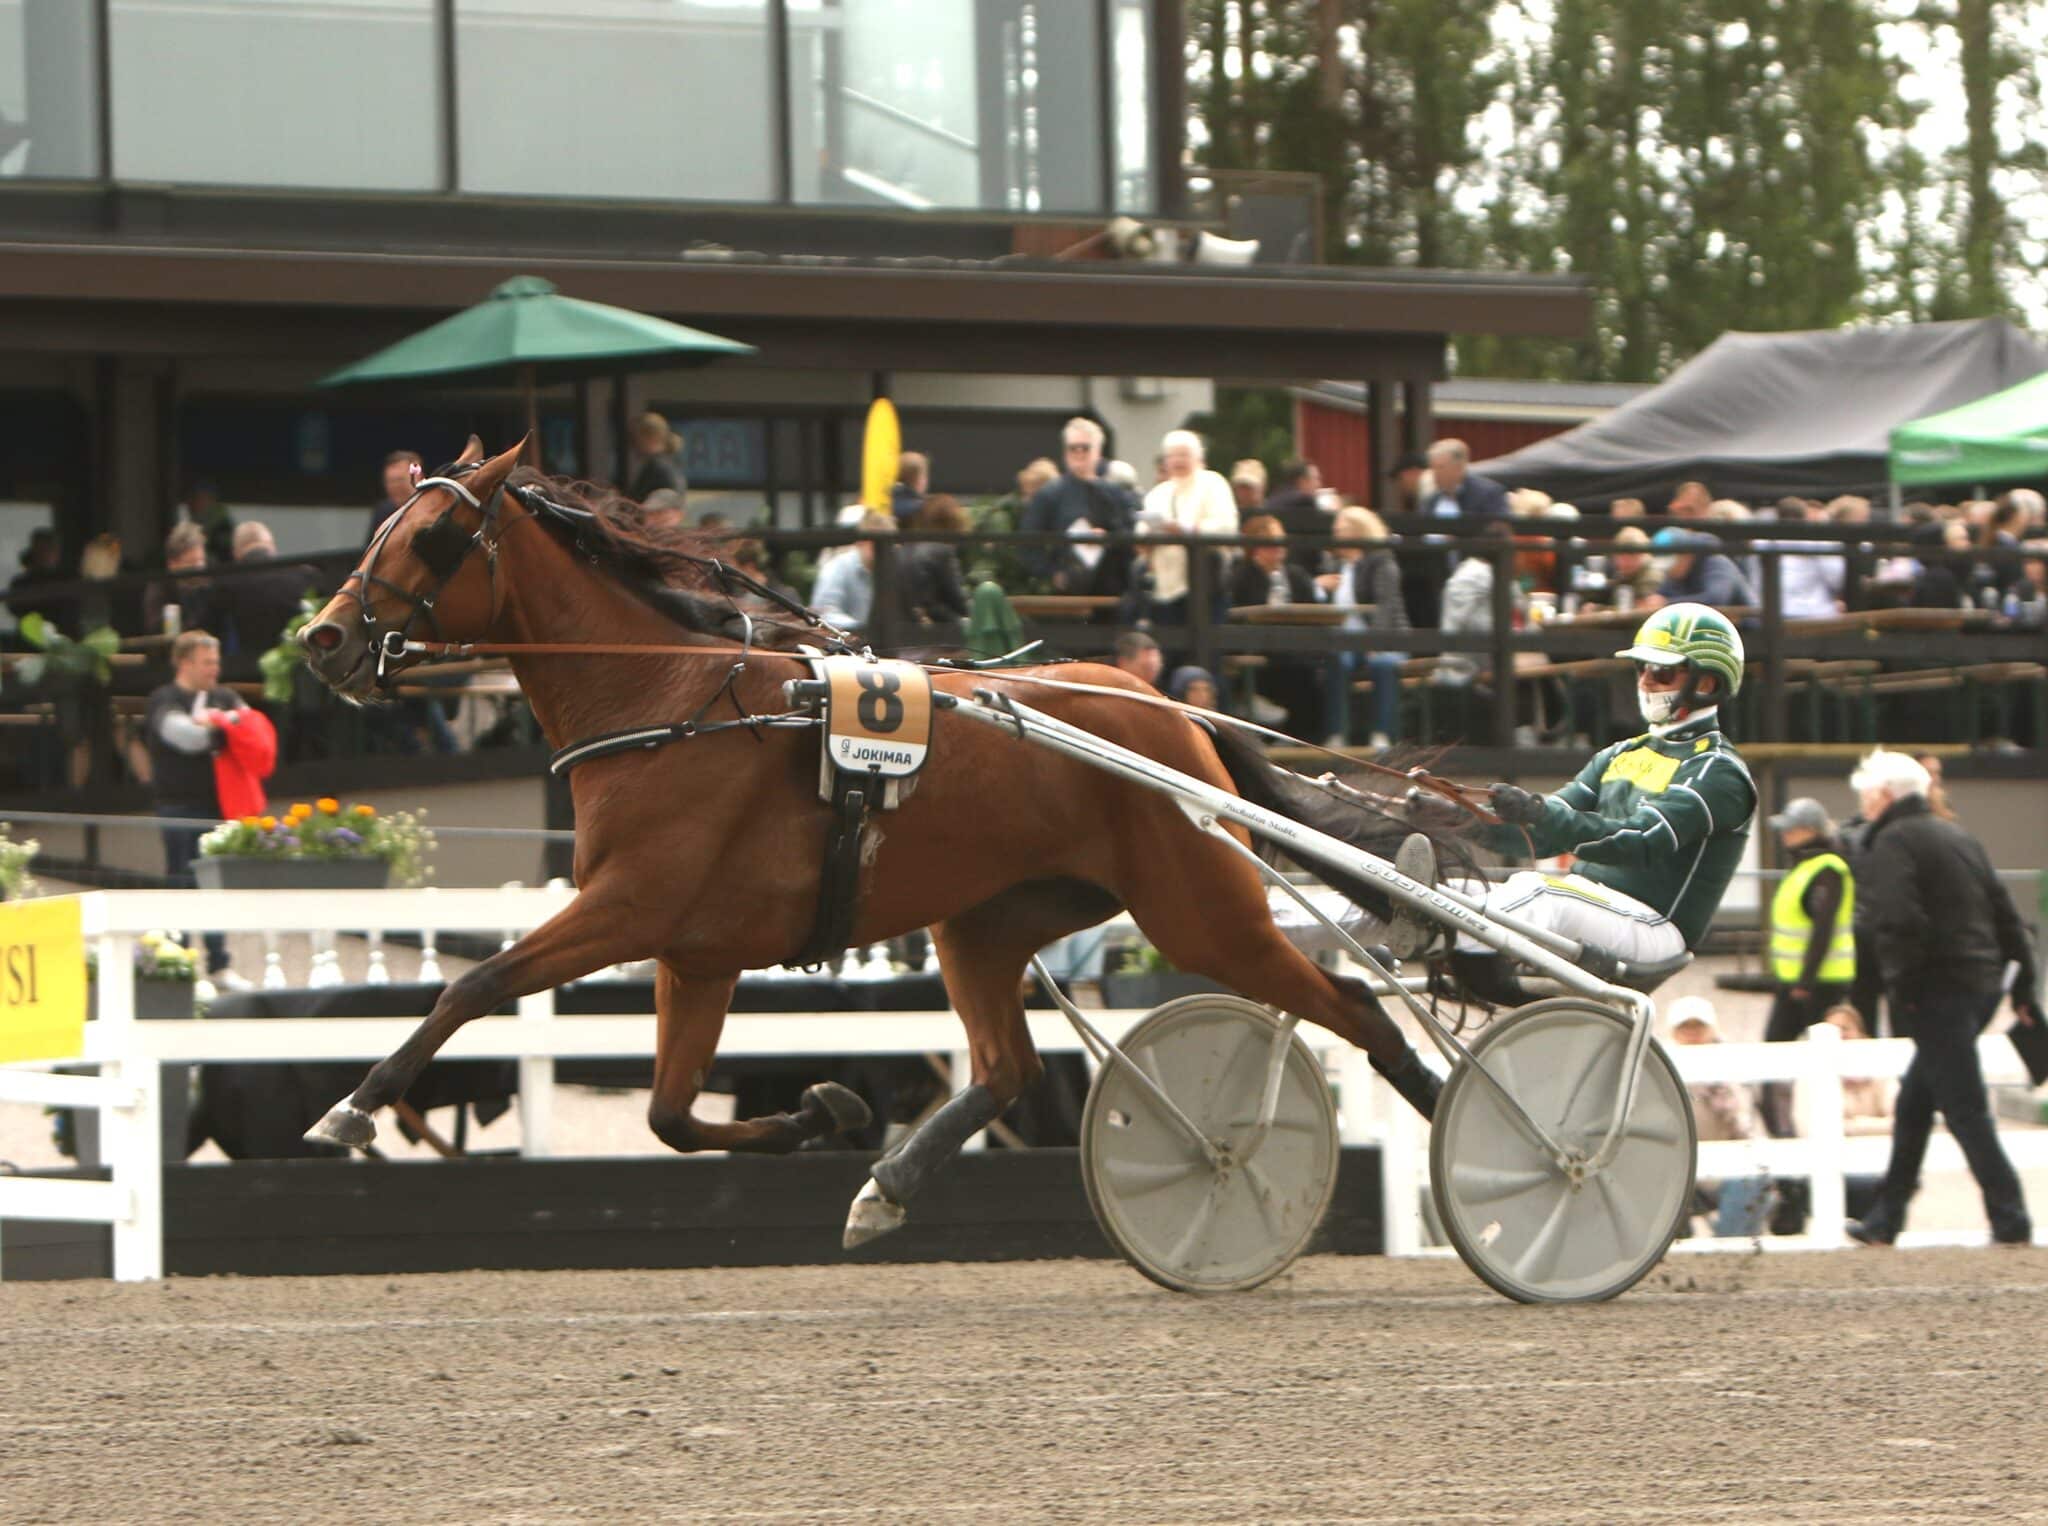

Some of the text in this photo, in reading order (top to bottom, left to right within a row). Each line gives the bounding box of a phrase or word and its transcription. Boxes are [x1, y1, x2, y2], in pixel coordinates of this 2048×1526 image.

[856, 670, 904, 733] 8
[852, 748, 912, 765] JOKIMAA
[0, 944, 40, 1006] SI
